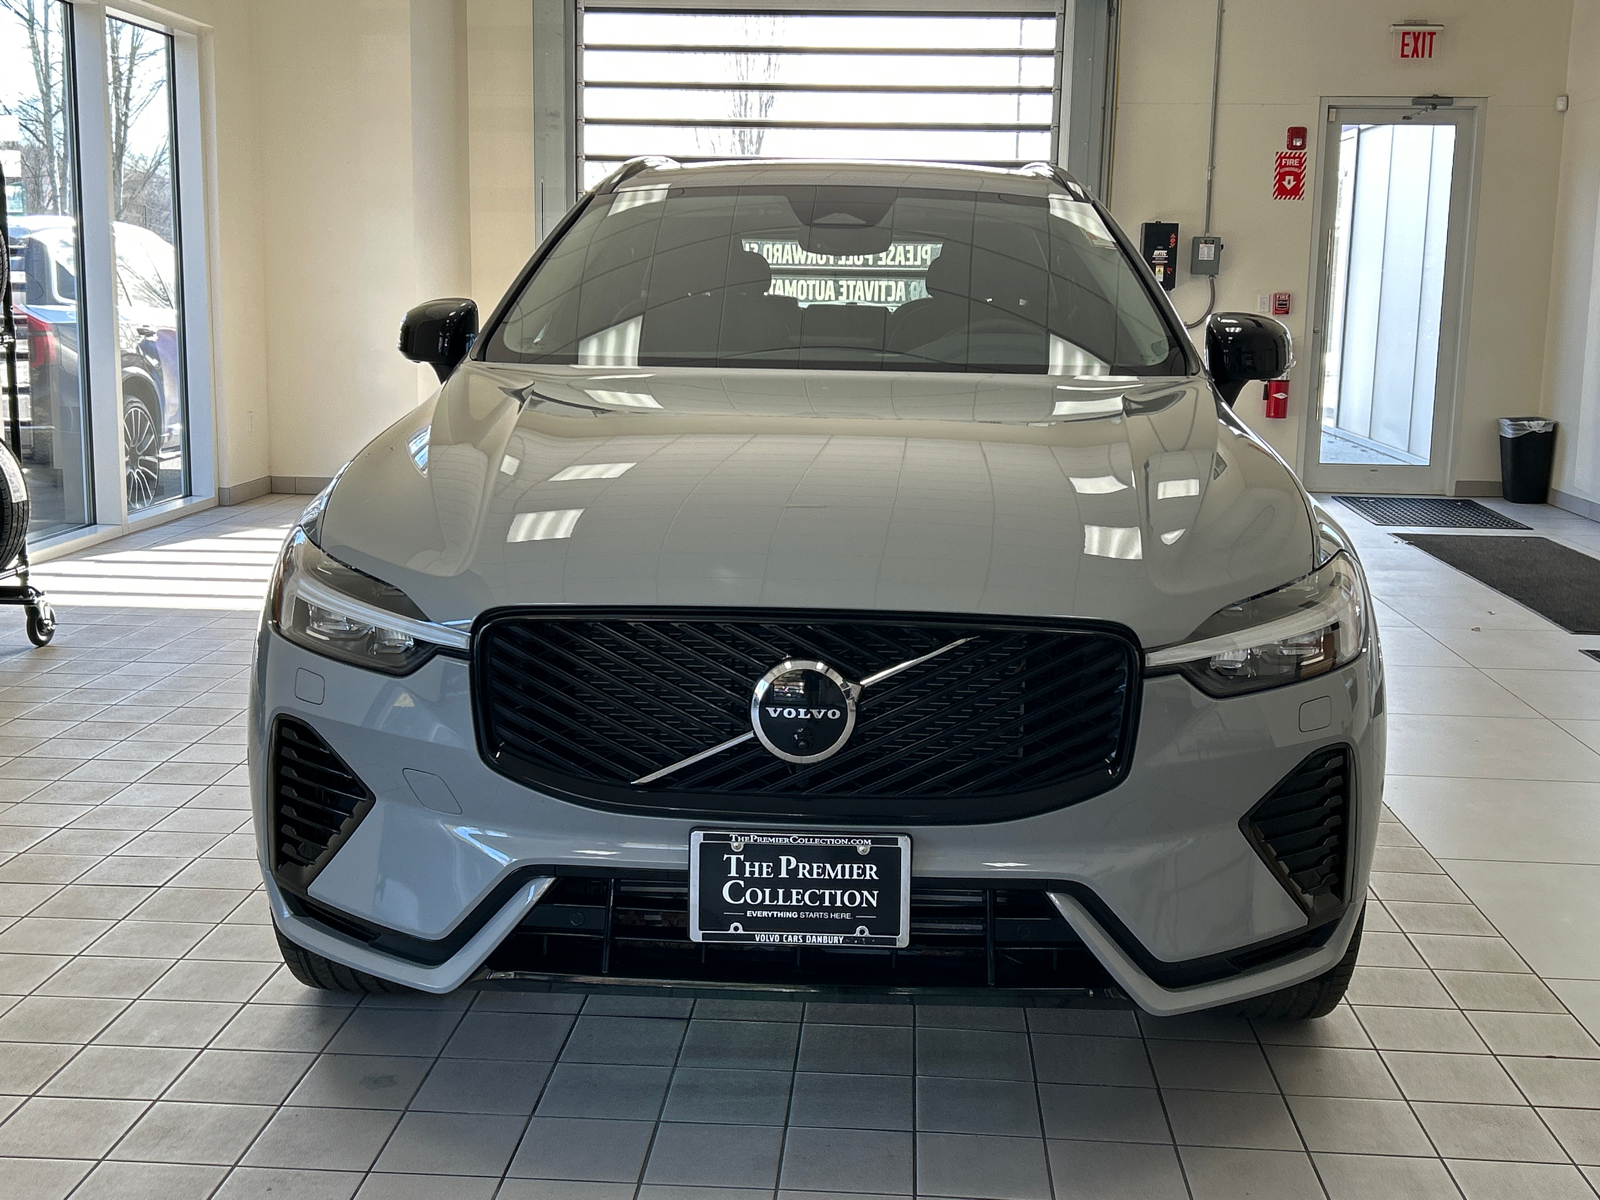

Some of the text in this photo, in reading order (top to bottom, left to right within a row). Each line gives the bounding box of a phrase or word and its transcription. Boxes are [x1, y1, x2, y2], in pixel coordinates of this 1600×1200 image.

[1400, 31, 1437, 58] EXIT
[1281, 158, 1300, 166] FIRE
[765, 707, 841, 719] VOLVO
[723, 854, 879, 880] THE PREMIER
[722, 880, 879, 908] COLLECTION
[746, 910, 798, 919] EVERYTHING
[755, 933, 844, 944] VOLVO CARS DANBURY
